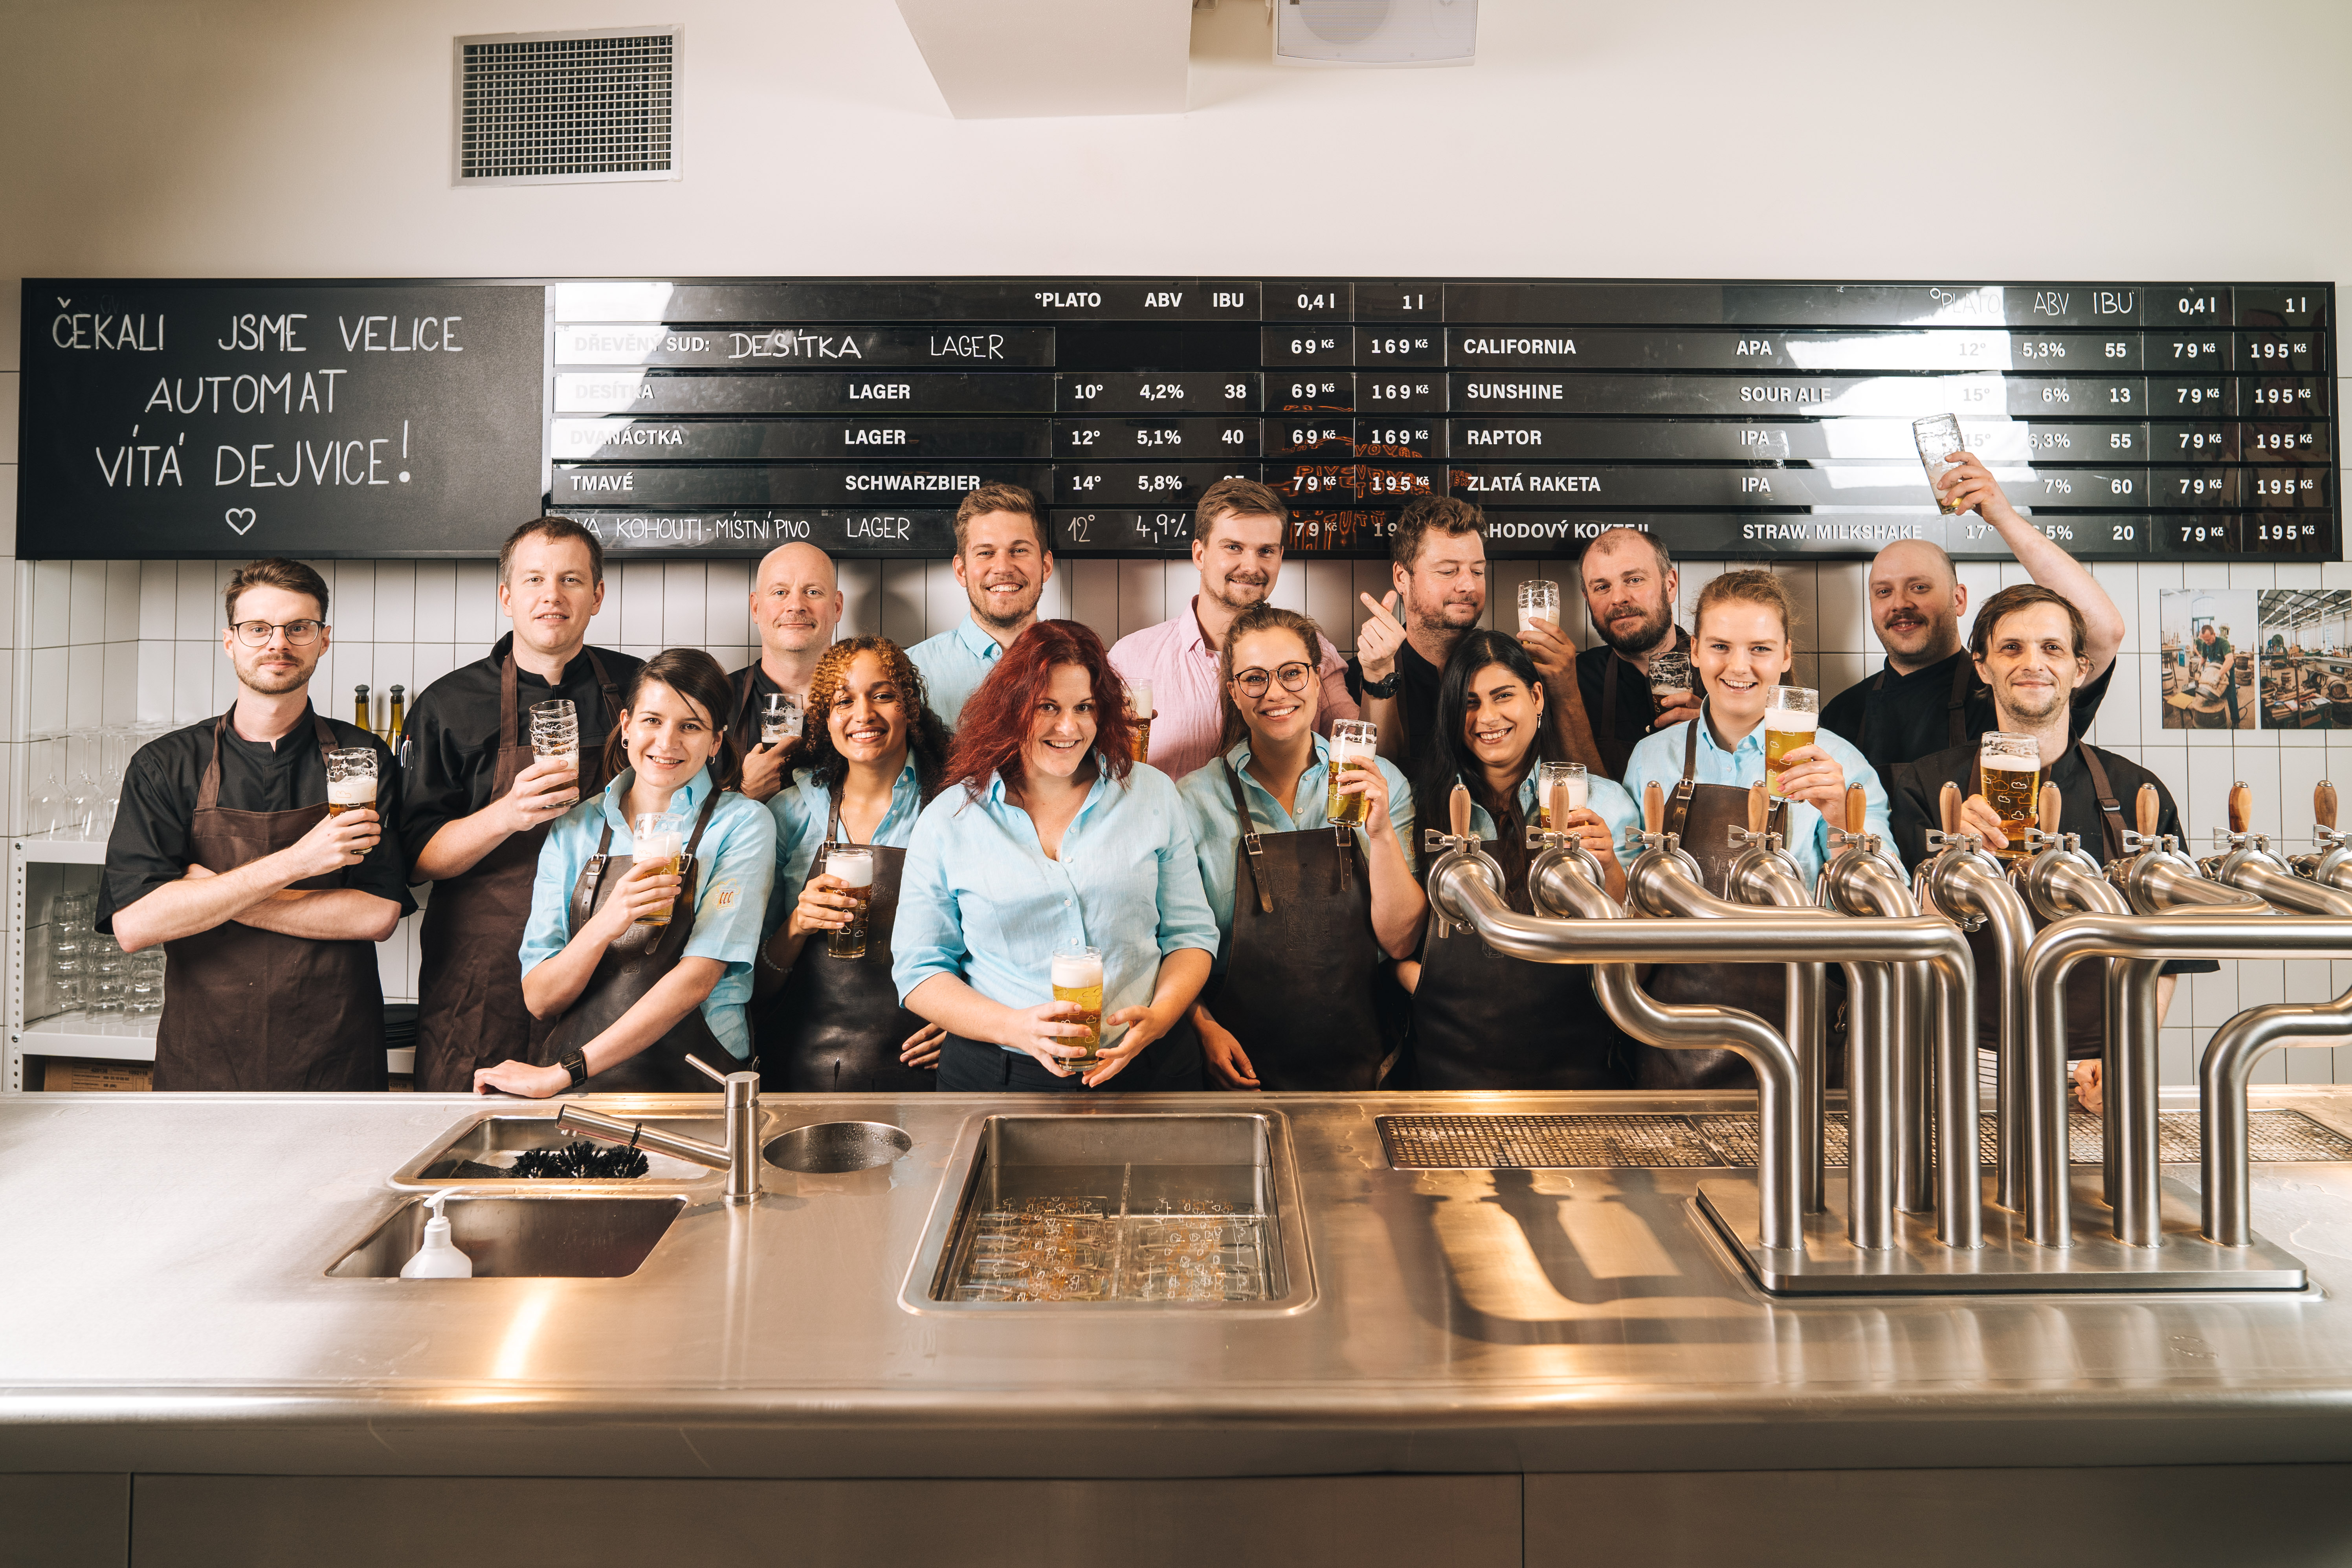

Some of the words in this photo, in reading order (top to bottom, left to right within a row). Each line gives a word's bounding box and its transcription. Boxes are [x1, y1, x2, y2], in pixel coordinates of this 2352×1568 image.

[1035, 292, 1101, 307] °PLATO
[1145, 292, 1182, 307] ABV
[1213, 293, 1244, 308] IBU
[1297, 294, 1324, 310] 0,4
[1403, 295, 1412, 309] 1
[2033, 292, 2069, 316] ABV
[2094, 292, 2132, 314] IBU
[2179, 298, 2205, 315] 0,4
[2286, 298, 2295, 312] 1
[53, 297, 164, 351] ČEKALI
[218, 314, 307, 352] JSME
[339, 315, 464, 352] VELICE
[666, 337, 710, 352] SUD:
[728, 329, 862, 359] DESÍTKA
[931, 334, 1004, 359] LAGER
[1292, 339, 1316, 354] 69
[1321, 339, 1334, 348] Kč
[1372, 339, 1409, 354] 169
[1415, 339, 1428, 348] Kč
[1464, 339, 1576, 354] CALIFORNIA
[1736, 340, 1772, 355] APA
[1959, 343, 1986, 356] 12°
[2023, 342, 2065, 359] 5,3%
[2105, 343, 2126, 358] 55
[2173, 343, 2198, 358] 79
[2203, 343, 2215, 352] Kč
[2251, 343, 2288, 358] 195
[2294, 343, 2306, 353] Kč
[145, 369, 347, 414] AUTOMAT
[850, 384, 910, 399] LAGER
[1075, 384, 1103, 399] 10°
[1140, 384, 1184, 401] 4,2%
[1225, 384, 1246, 399] 38
[1292, 383, 1316, 398] 69
[1322, 383, 1335, 392] Kč
[1372, 385, 1410, 399] 169
[1416, 384, 1429, 394] Kč
[1468, 383, 1563, 399] SUNSHINE
[1740, 387, 1791, 402] SOUR
[1796, 388, 1831, 402] ALE
[1963, 389, 1990, 401] 15°
[2042, 387, 2069, 402] 6%
[2110, 388, 2130, 403] 13
[2177, 389, 2202, 403] 79
[2207, 388, 2219, 398] Kč
[2255, 389, 2293, 403] 195
[2298, 389, 2311, 398] Kč
[845, 429, 906, 444] LAGER
[1072, 430, 1100, 445] 12°
[1137, 430, 1181, 446] 5,1%
[1222, 429, 1244, 444] 40
[1293, 429, 1317, 444] 69
[1323, 430, 1336, 439] Kč
[1372, 429, 1410, 444] 169
[1416, 430, 1428, 439] Kč
[1468, 430, 1541, 445] RAPTOR
[1741, 431, 1769, 445] IPA
[2029, 434, 2070, 449] 6,3%
[2110, 433, 2131, 448] 55
[2180, 433, 2203, 448] 79
[2209, 433, 2222, 443] Kč
[2257, 434, 2294, 449] 195
[2300, 434, 2312, 443] Kč
[96, 424, 184, 487] VÍTÁ
[215, 419, 411, 487] DEJVICE!
[570, 472, 633, 490] TMAVÉ
[846, 475, 980, 490] SCHWARZBIER
[1073, 475, 1101, 490] 14°
[1138, 475, 1182, 492] 5,8%
[1293, 476, 1318, 491] 79
[1323, 476, 1336, 485] Kč
[1372, 476, 1411, 491] 195
[1416, 476, 1429, 486] Kč
[1467, 473, 1524, 491] ZLATÁ
[1530, 477, 1601, 491] RAKETA
[1742, 478, 1771, 492] IPA
[2044, 479, 2071, 493] 7%
[2111, 479, 2132, 494] 60
[2180, 479, 2204, 494] 79
[2209, 479, 2222, 489] Kč
[2257, 479, 2295, 494] 195
[2301, 479, 2313, 489] Kč
[616, 518, 702, 541] KOHOUTI
[775, 519, 810, 539] PIVO
[847, 517, 910, 540] LAGER
[1068, 514, 1095, 542] 12°
[1136, 513, 1186, 543] 4,9%
[1294, 522, 1319, 537] 79
[1325, 523, 1337, 532] Kč
[1374, 523, 1396, 537] 19
[1743, 525, 1809, 539] STRAW.
[1816, 525, 1922, 539] MILKSHAKE
[1967, 525, 1994, 539] 17°
[2113, 525, 2134, 540] 20
[2181, 527, 2205, 542] 79
[2211, 527, 2224, 536] Kč
[2259, 525, 2297, 540] 195
[2302, 525, 2315, 535] Kč
